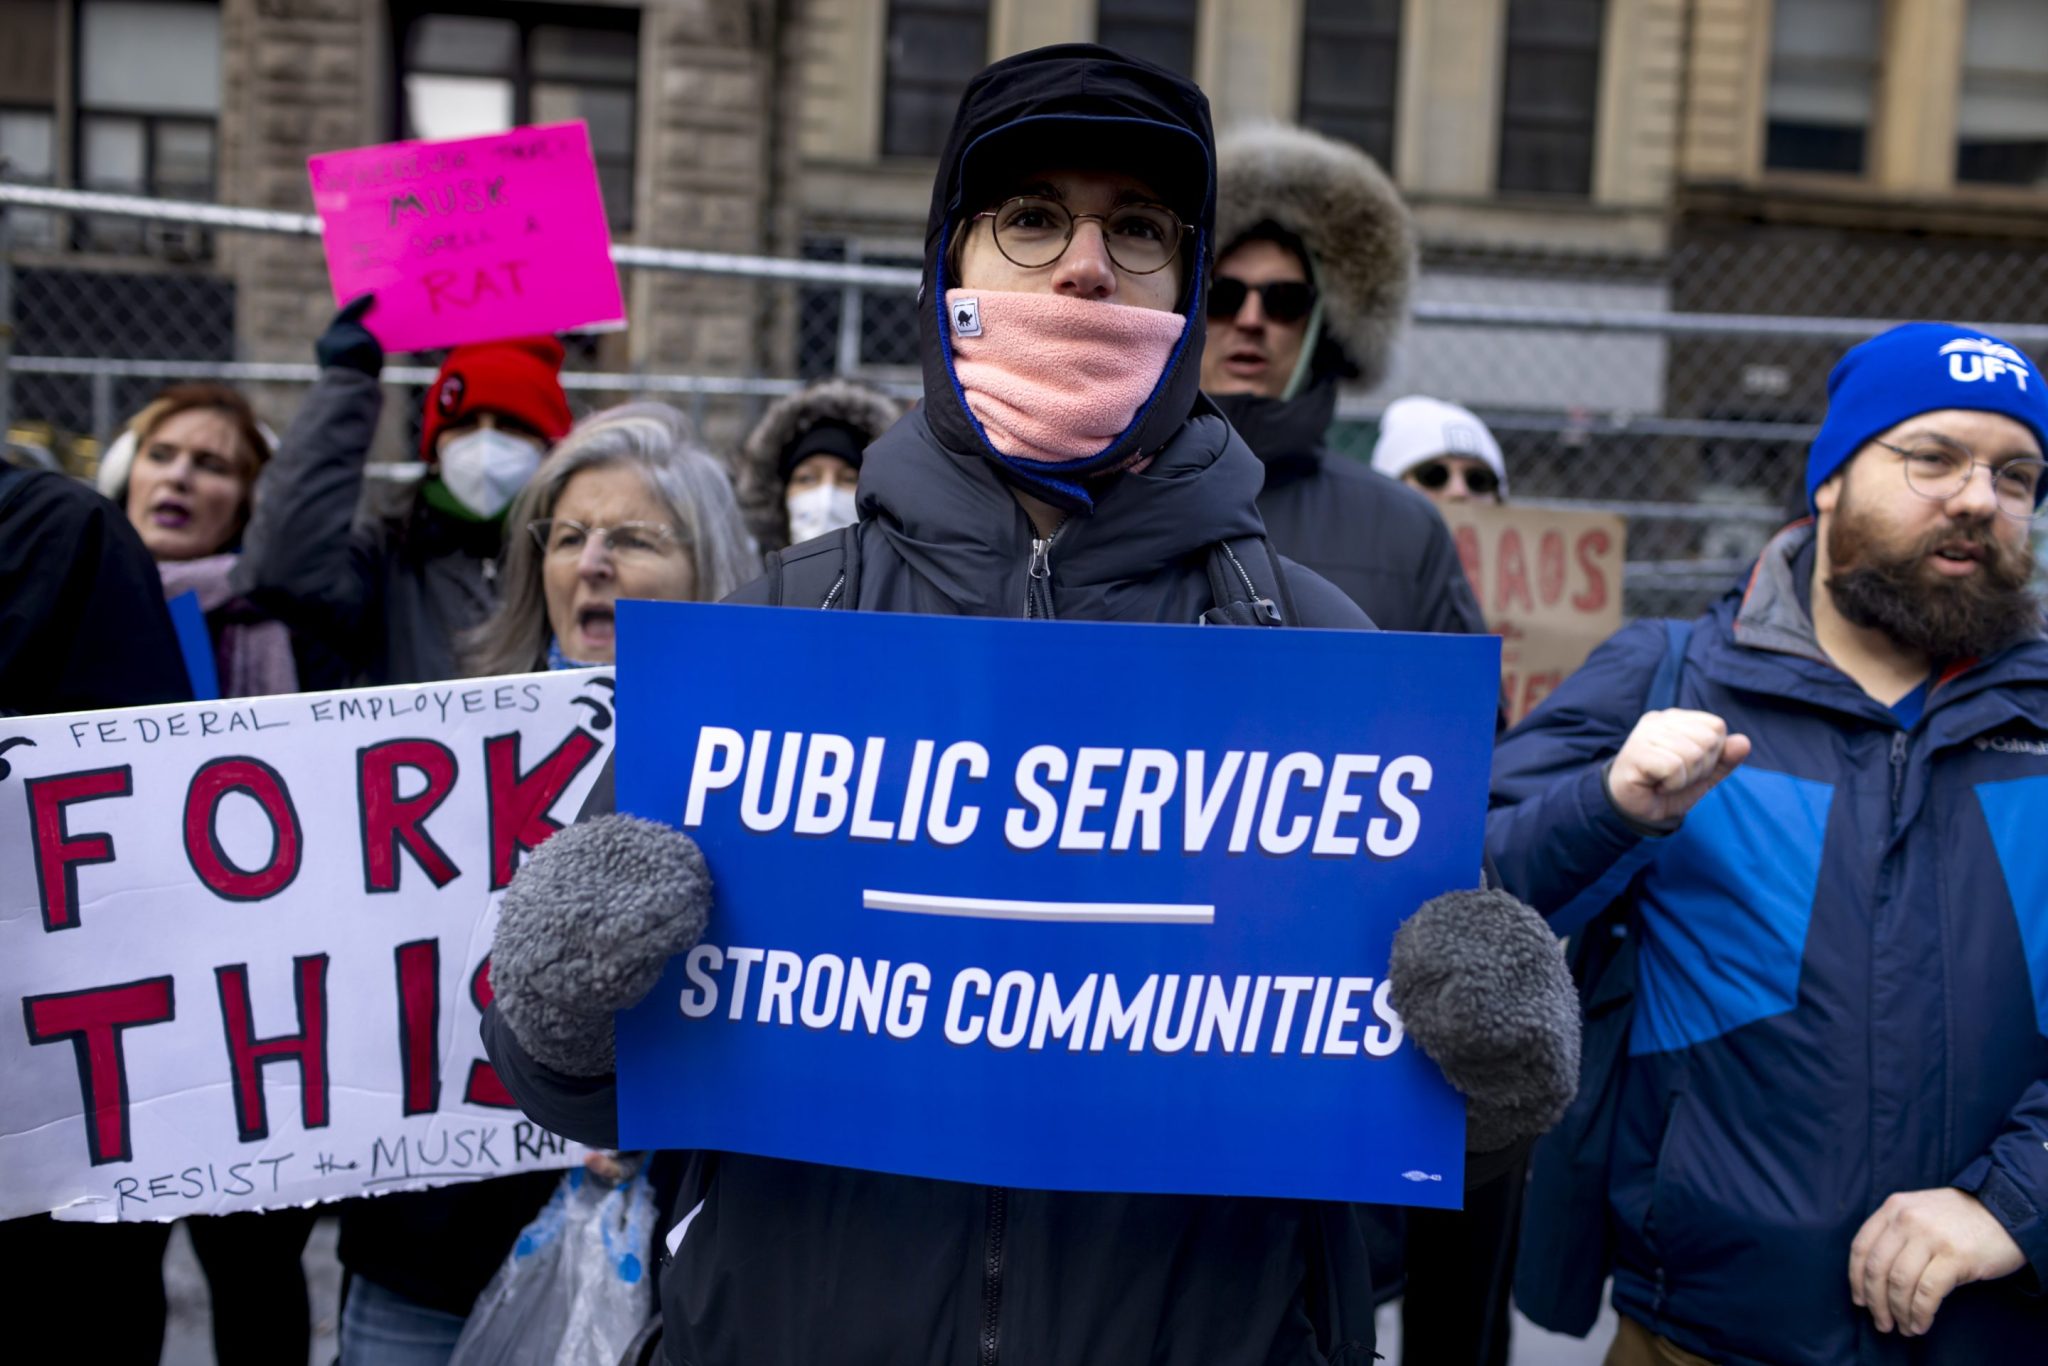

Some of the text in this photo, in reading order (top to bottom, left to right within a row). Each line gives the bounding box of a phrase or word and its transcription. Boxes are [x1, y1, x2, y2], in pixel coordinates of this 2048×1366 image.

[388, 174, 511, 228] MUSK
[419, 259, 527, 315] RAT
[1948, 352, 2030, 392] UFT
[69, 684, 542, 748] FEDERAL EMPLOYEES
[684, 725, 1434, 859] PUBLIC SERVICES
[24, 730, 604, 932] FORK
[680, 944, 1404, 1058] STRONG COMMUNITIES
[114, 1153, 294, 1211] RESIST
[313, 1152, 360, 1175] the
[370, 1128, 500, 1178] MUSK
